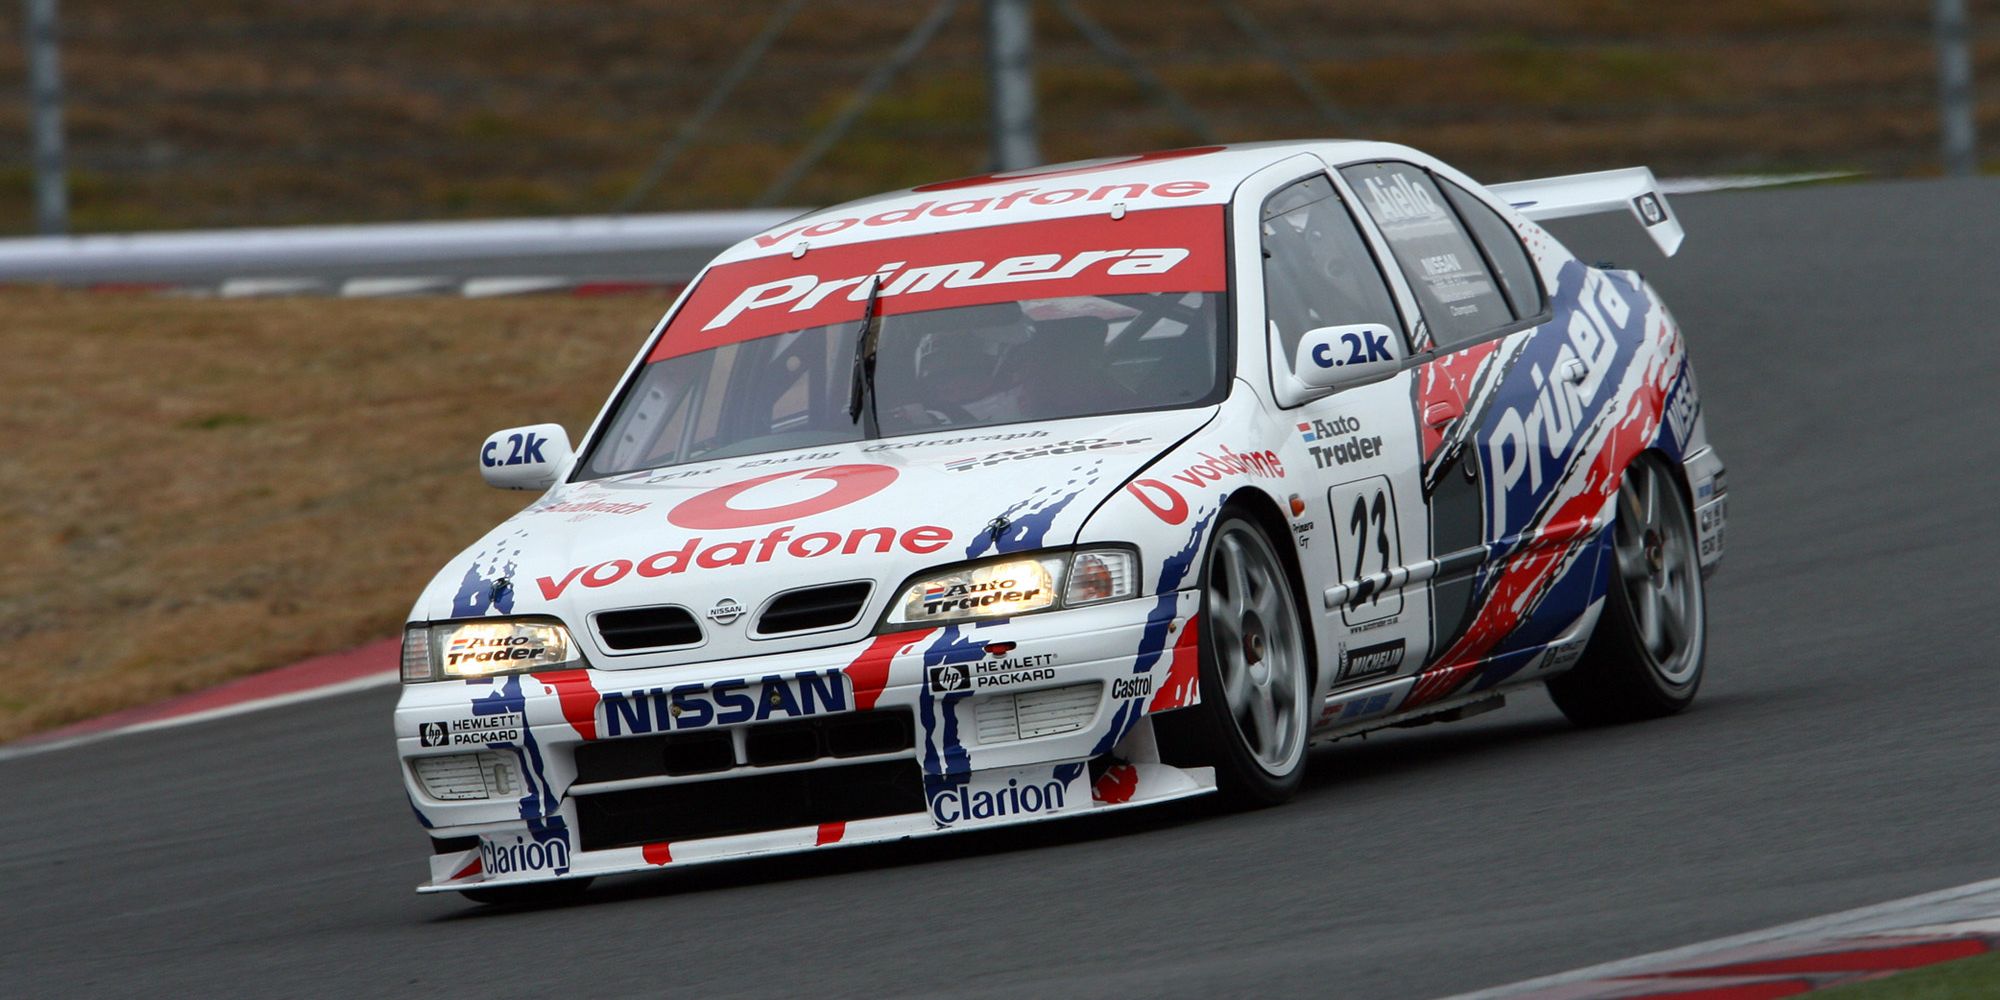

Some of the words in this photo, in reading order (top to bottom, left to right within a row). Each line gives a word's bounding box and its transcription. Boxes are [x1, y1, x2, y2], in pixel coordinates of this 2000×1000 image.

[1364, 173, 1437, 220] Aiello
[752, 180, 1211, 249] vodafone
[701, 247, 1190, 333] Primera
[1311, 330, 1394, 369] c.2k
[1489, 268, 1630, 543] Primera
[1312, 416, 1360, 440] Auto
[482, 432, 548, 468] c.2k
[644, 467, 721, 484] The
[736, 451, 841, 470] Daily
[861, 430, 1051, 452] Telegraph
[946, 437, 1152, 472] Trader
[983, 438, 1108, 460] Auto
[1308, 434, 1383, 469] Trader
[1172, 444, 1286, 488] vodafone
[535, 524, 953, 602] vodafone
[1349, 489, 1392, 612] 23
[923, 588, 1040, 615] Trader
[944, 579, 1016, 598] Auto
[710, 605, 742, 616] NISSAN
[447, 647, 545, 666] Trader
[467, 635, 529, 649] Auto
[976, 654, 1053, 673] HEWLETT
[1348, 646, 1404, 677] MICHELIN
[977, 669, 1056, 688] PACKARD
[1111, 674, 1152, 700] Castrol
[602, 667, 847, 737] NISSAN
[452, 714, 516, 731] HEWLETT
[454, 729, 518, 745] PACKARD
